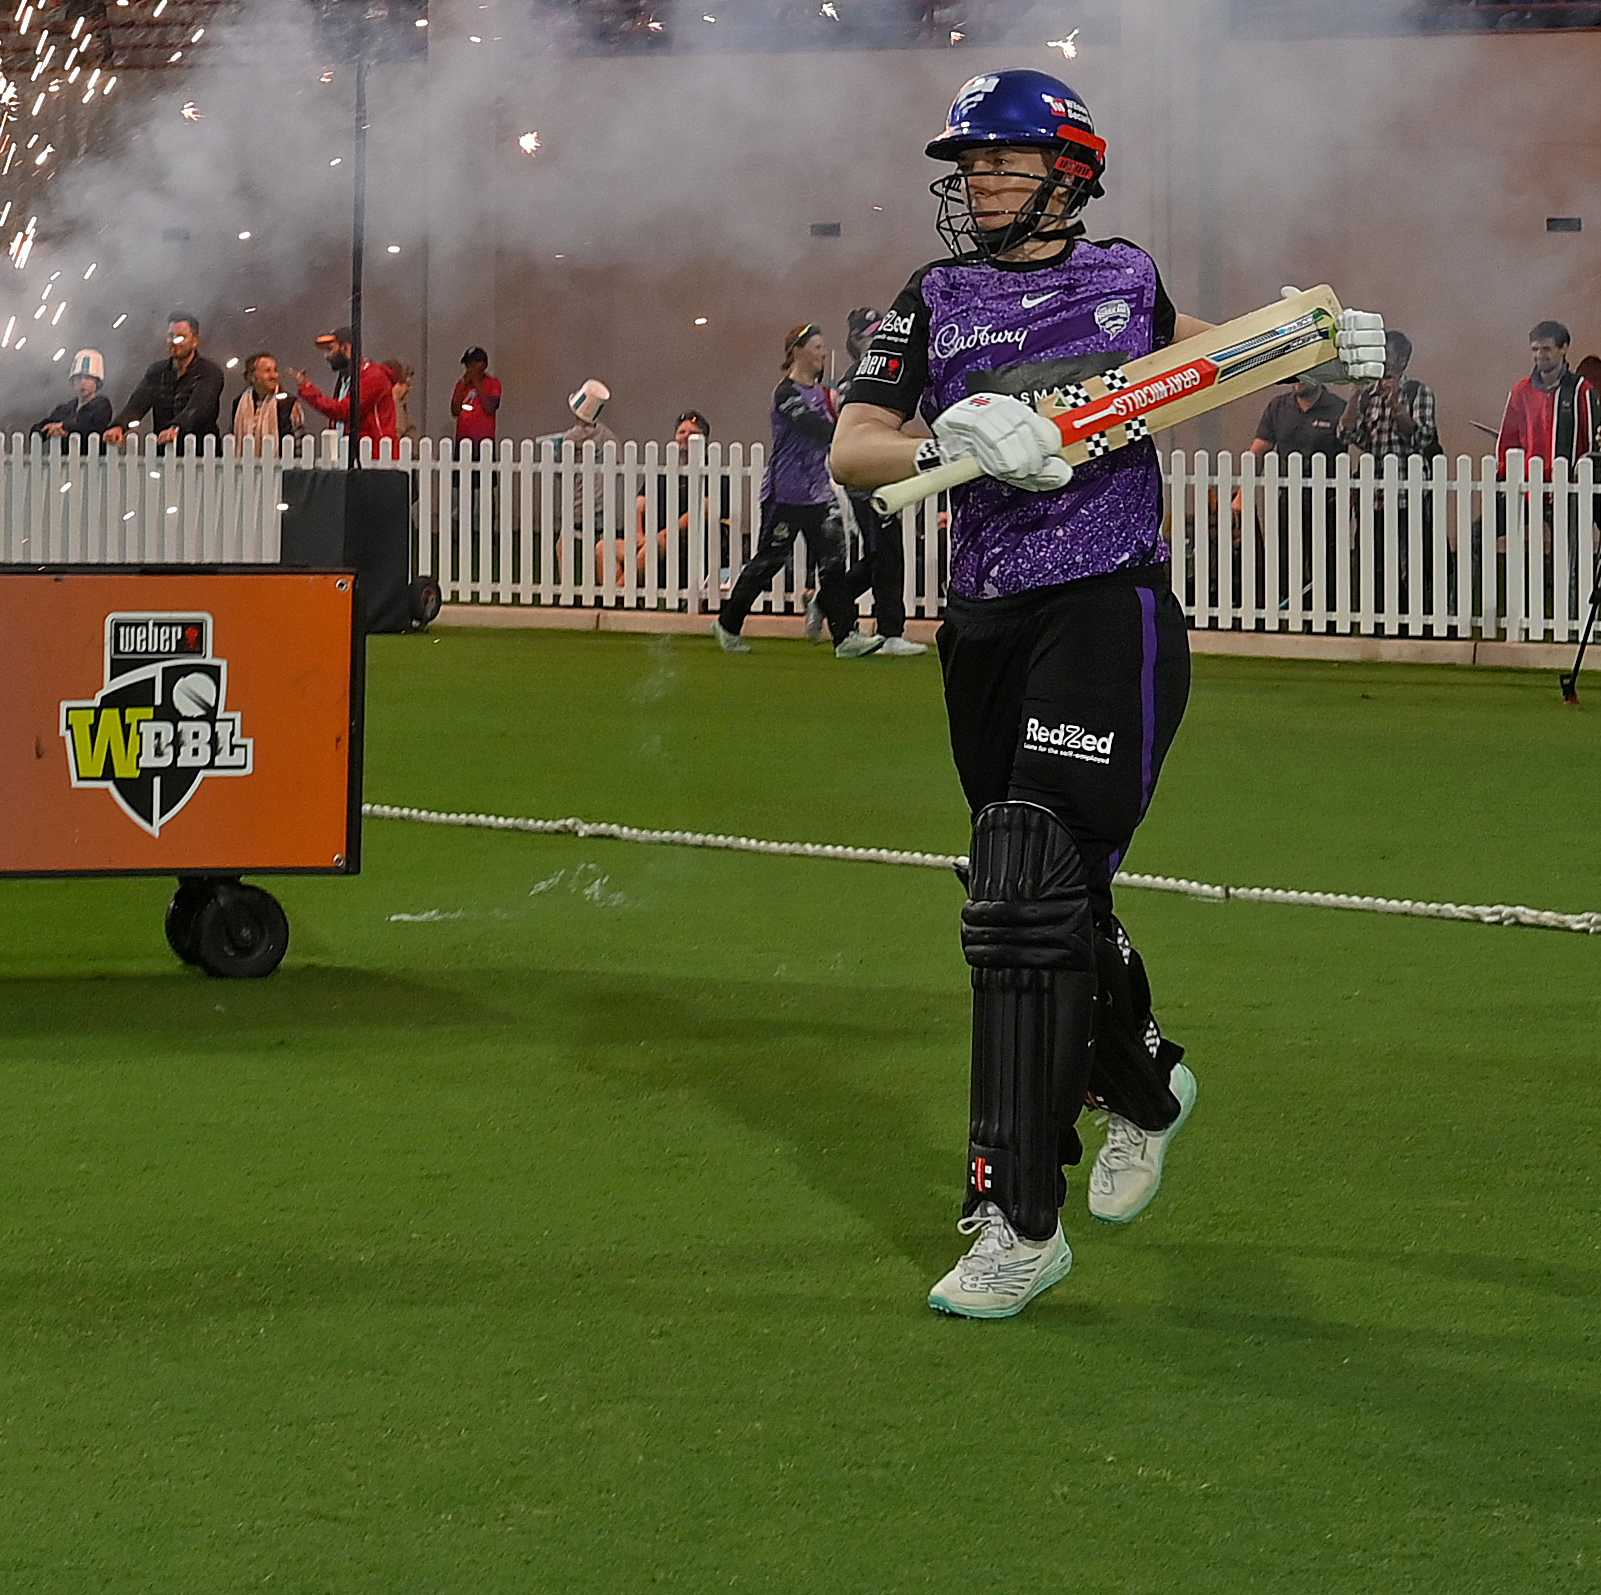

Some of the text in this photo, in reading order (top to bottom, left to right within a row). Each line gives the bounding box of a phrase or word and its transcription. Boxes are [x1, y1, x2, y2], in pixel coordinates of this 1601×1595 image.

[935, 323, 1029, 359] Cadbury
[855, 350, 888, 376] ber
[1114, 367, 1201, 416] GRAY-NICOLLS
[119, 620, 183, 653] weber
[68, 707, 246, 779] WBBL
[1026, 717, 1115, 755] RedZed
